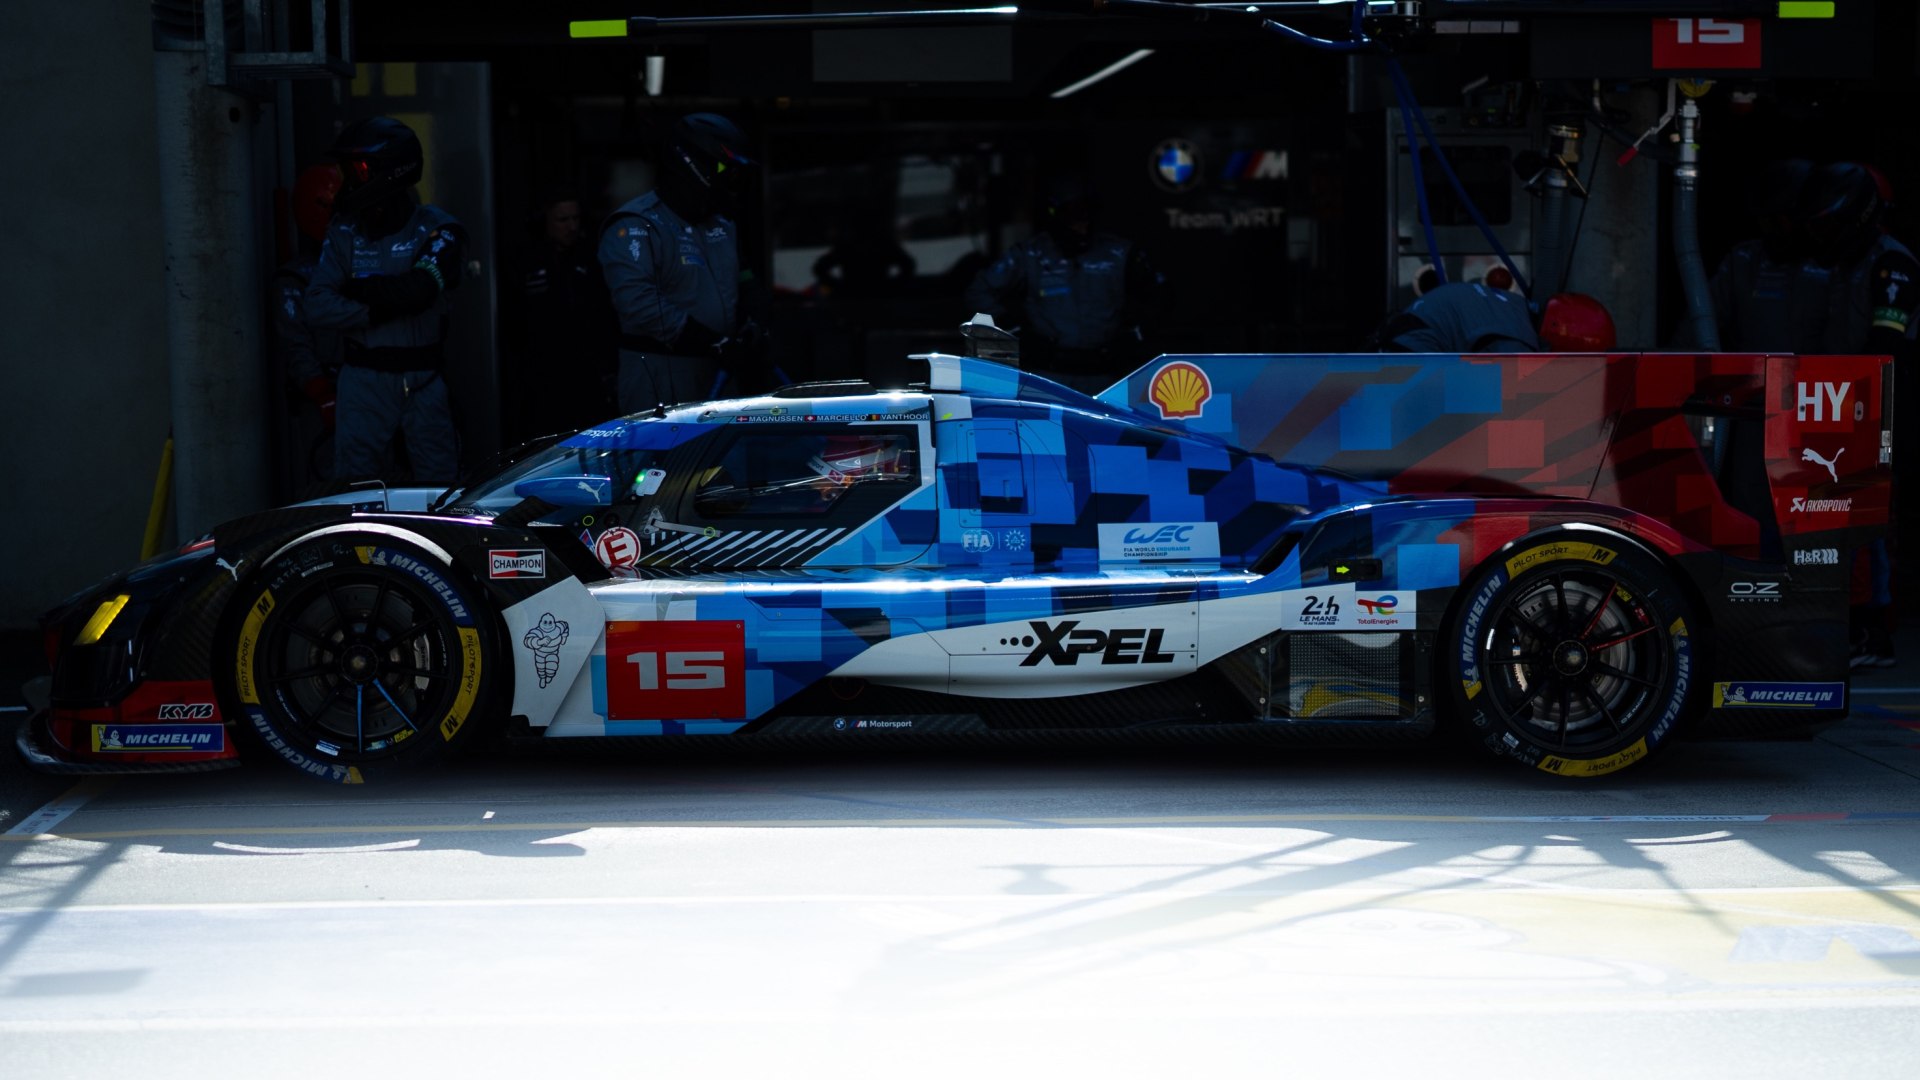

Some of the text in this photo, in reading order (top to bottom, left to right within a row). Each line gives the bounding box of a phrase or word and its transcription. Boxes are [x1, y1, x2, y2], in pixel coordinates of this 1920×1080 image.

[1668, 17, 1745, 44] 15
[1163, 206, 1286, 230] Team WRT
[1797, 381, 1852, 422] HY
[816, 414, 868, 422] MARCIELLO
[880, 413, 930, 421] VANTHOOR
[963, 534, 991, 548] FIA
[1123, 525, 1195, 544] WEC
[603, 532, 633, 566] E
[1513, 547, 1610, 570] PILOT SPORT M
[1793, 549, 1822, 565] H&R
[493, 559, 542, 569] CHAMPION
[390, 553, 468, 618] MICHELIN
[1462, 574, 1502, 663] MICHELIN
[1019, 621, 1175, 666] XPEL
[241, 636, 251, 696] PILOT SPORT
[466, 634, 476, 695] PILOT SPORT
[625, 651, 727, 690] 15
[1652, 653, 1689, 741] MICHELIN
[1750, 690, 1834, 701] MICHELIN
[158, 703, 215, 720] KYB
[869, 720, 913, 728] Motorsport
[125, 733, 211, 744] MICHELIN
[250, 713, 329, 776] MICHELIN
[1587, 759, 1616, 772] SPORT
